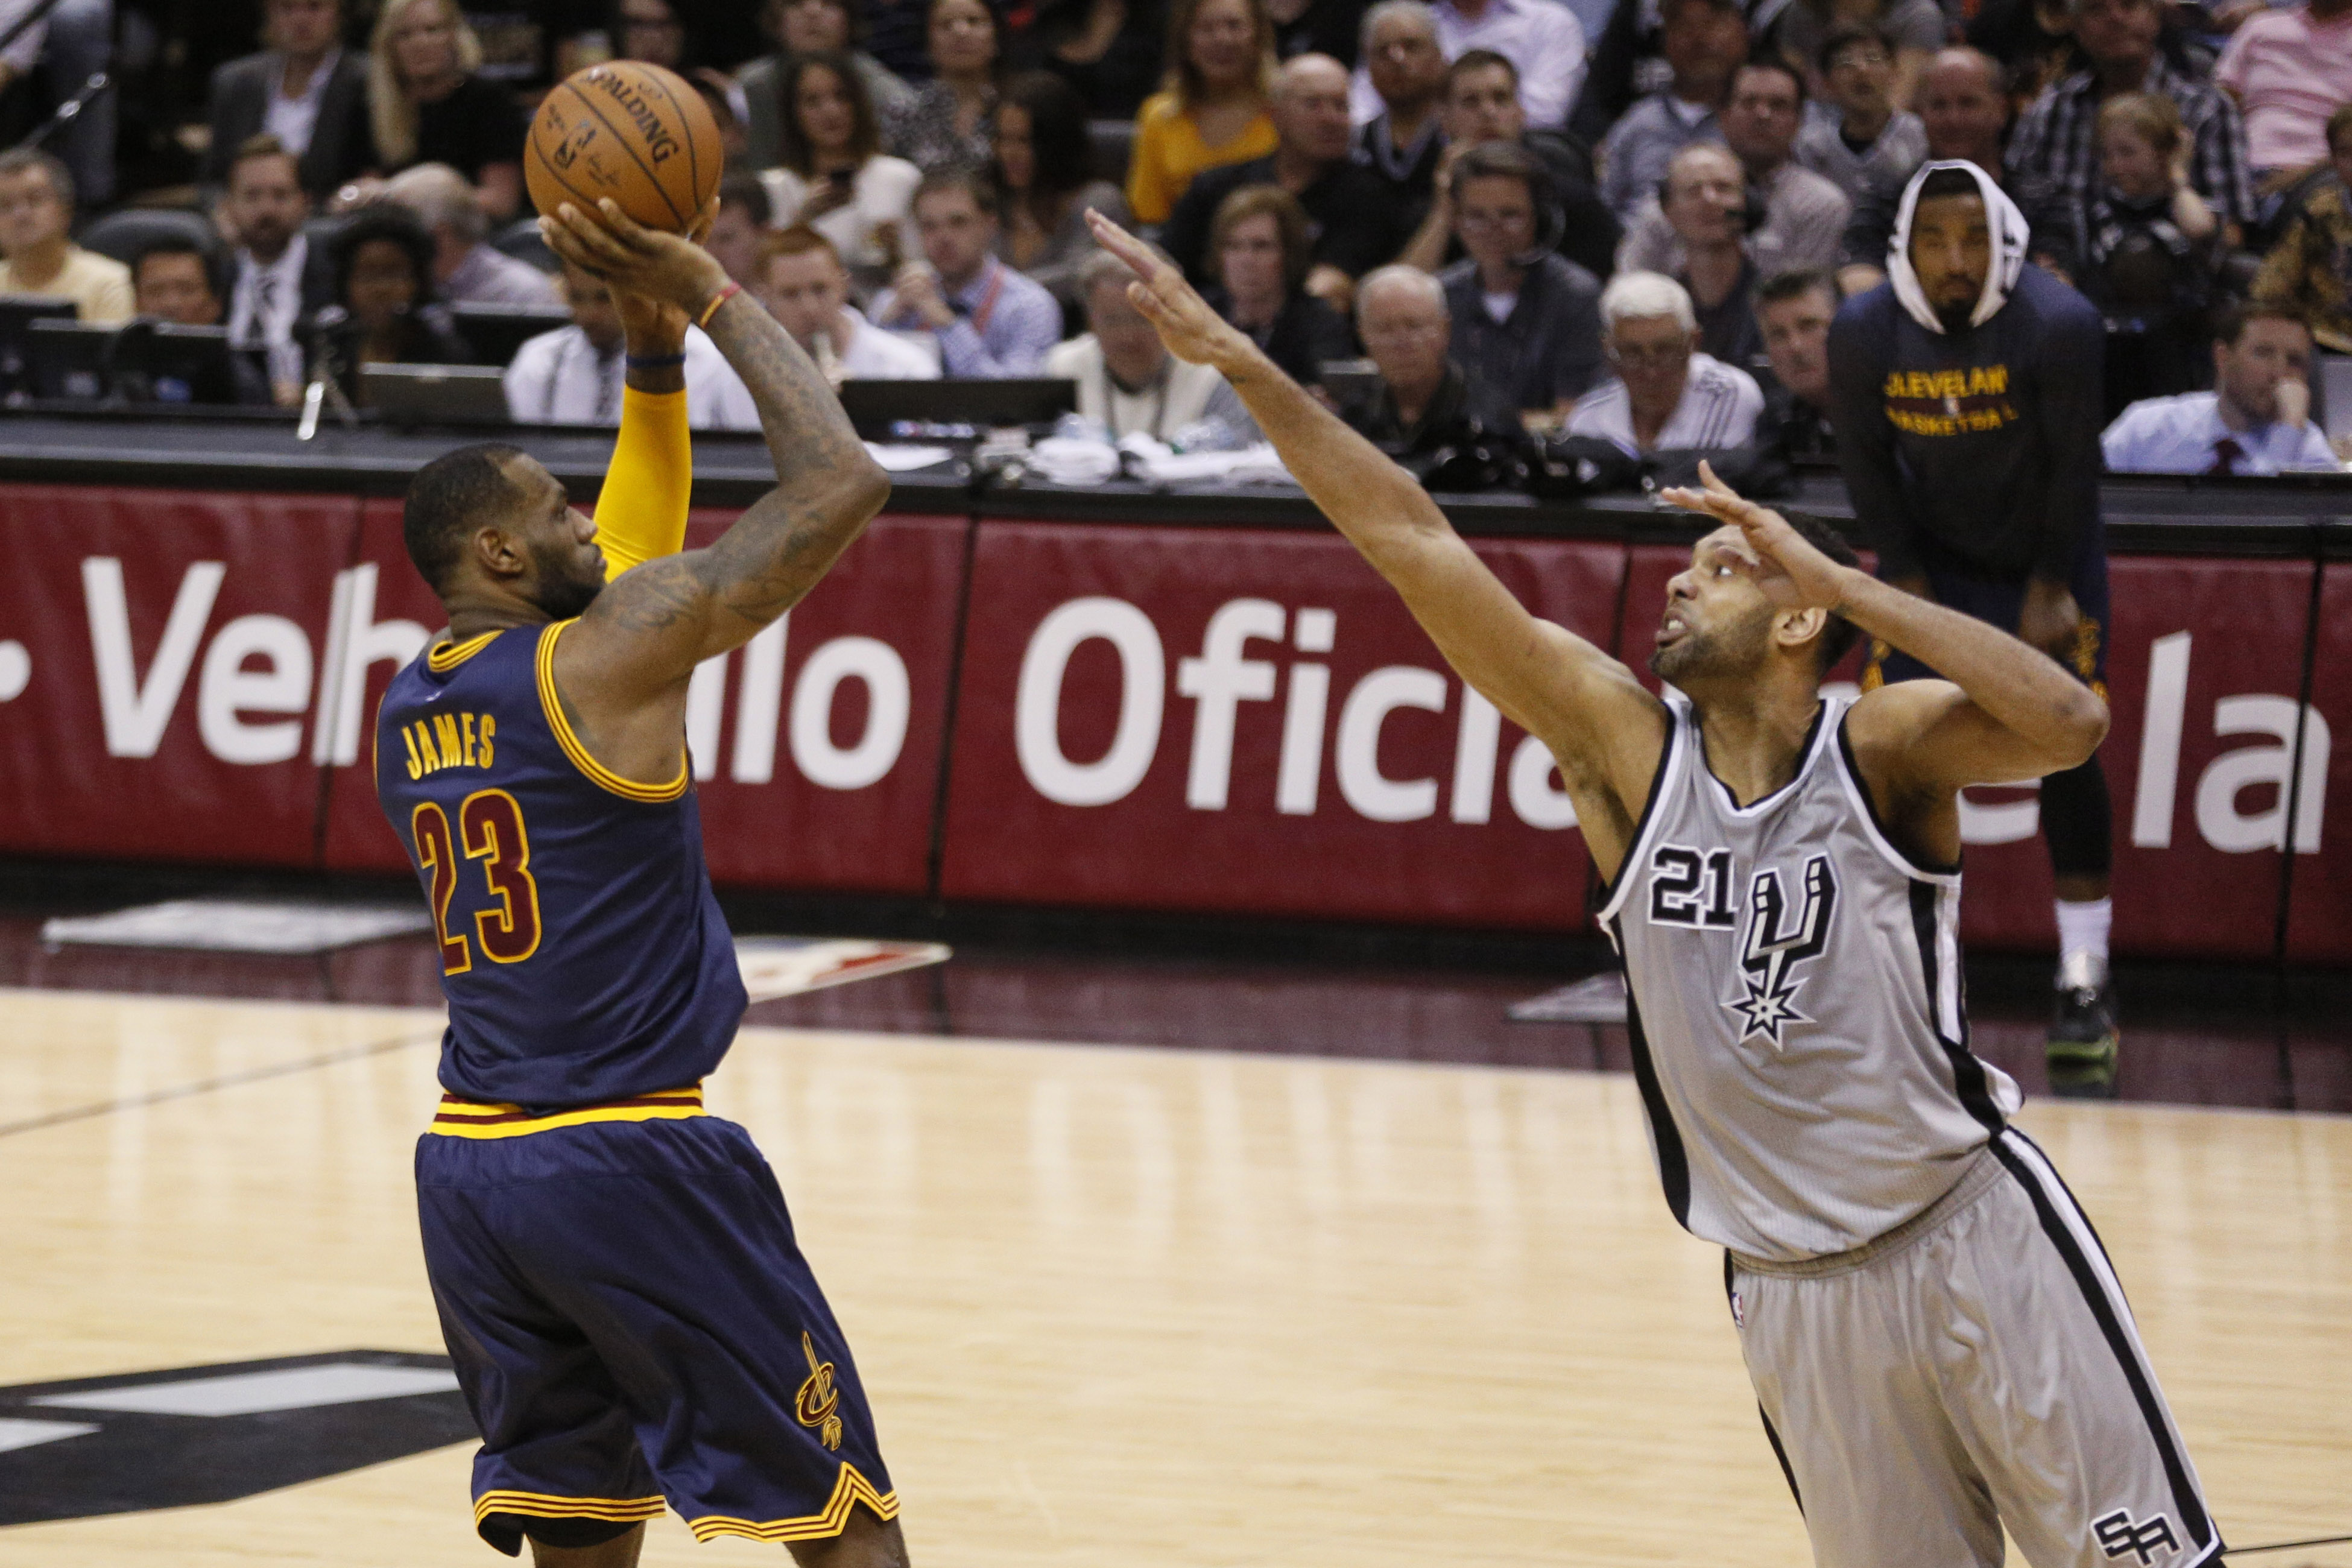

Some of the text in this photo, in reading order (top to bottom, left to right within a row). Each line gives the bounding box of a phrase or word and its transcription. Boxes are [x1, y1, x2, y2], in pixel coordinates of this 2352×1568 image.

[80, 555, 912, 791] Vehlo
[2131, 629, 2332, 855] la
[400, 712, 496, 780] JAMES
[411, 787, 542, 978] 23
[1648, 842, 1740, 931] 21
[2089, 1506, 2184, 1568] SA
